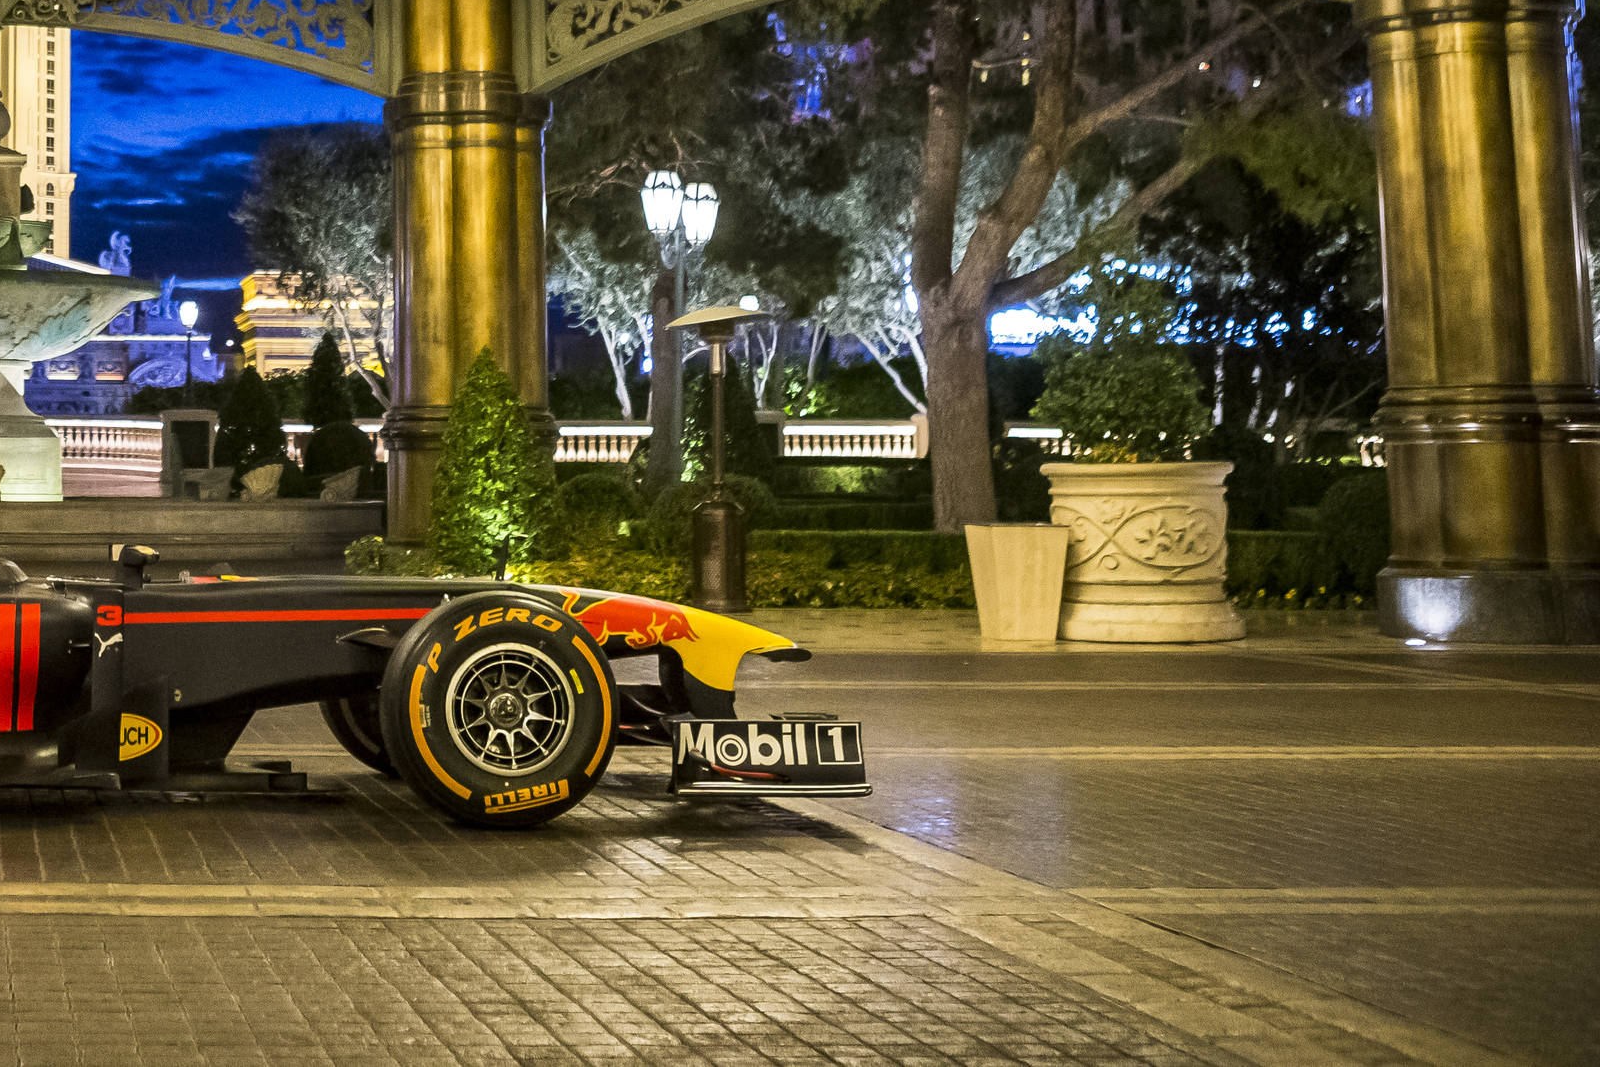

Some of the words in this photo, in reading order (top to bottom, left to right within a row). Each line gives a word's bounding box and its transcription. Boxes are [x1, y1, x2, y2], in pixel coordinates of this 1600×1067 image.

[96, 605, 123, 627] 3
[427, 642, 443, 674] P
[454, 607, 563, 642] ZERO
[677, 722, 809, 767] Mobil
[827, 726, 845, 762] 1
[483, 779, 570, 815] PIRELLI
